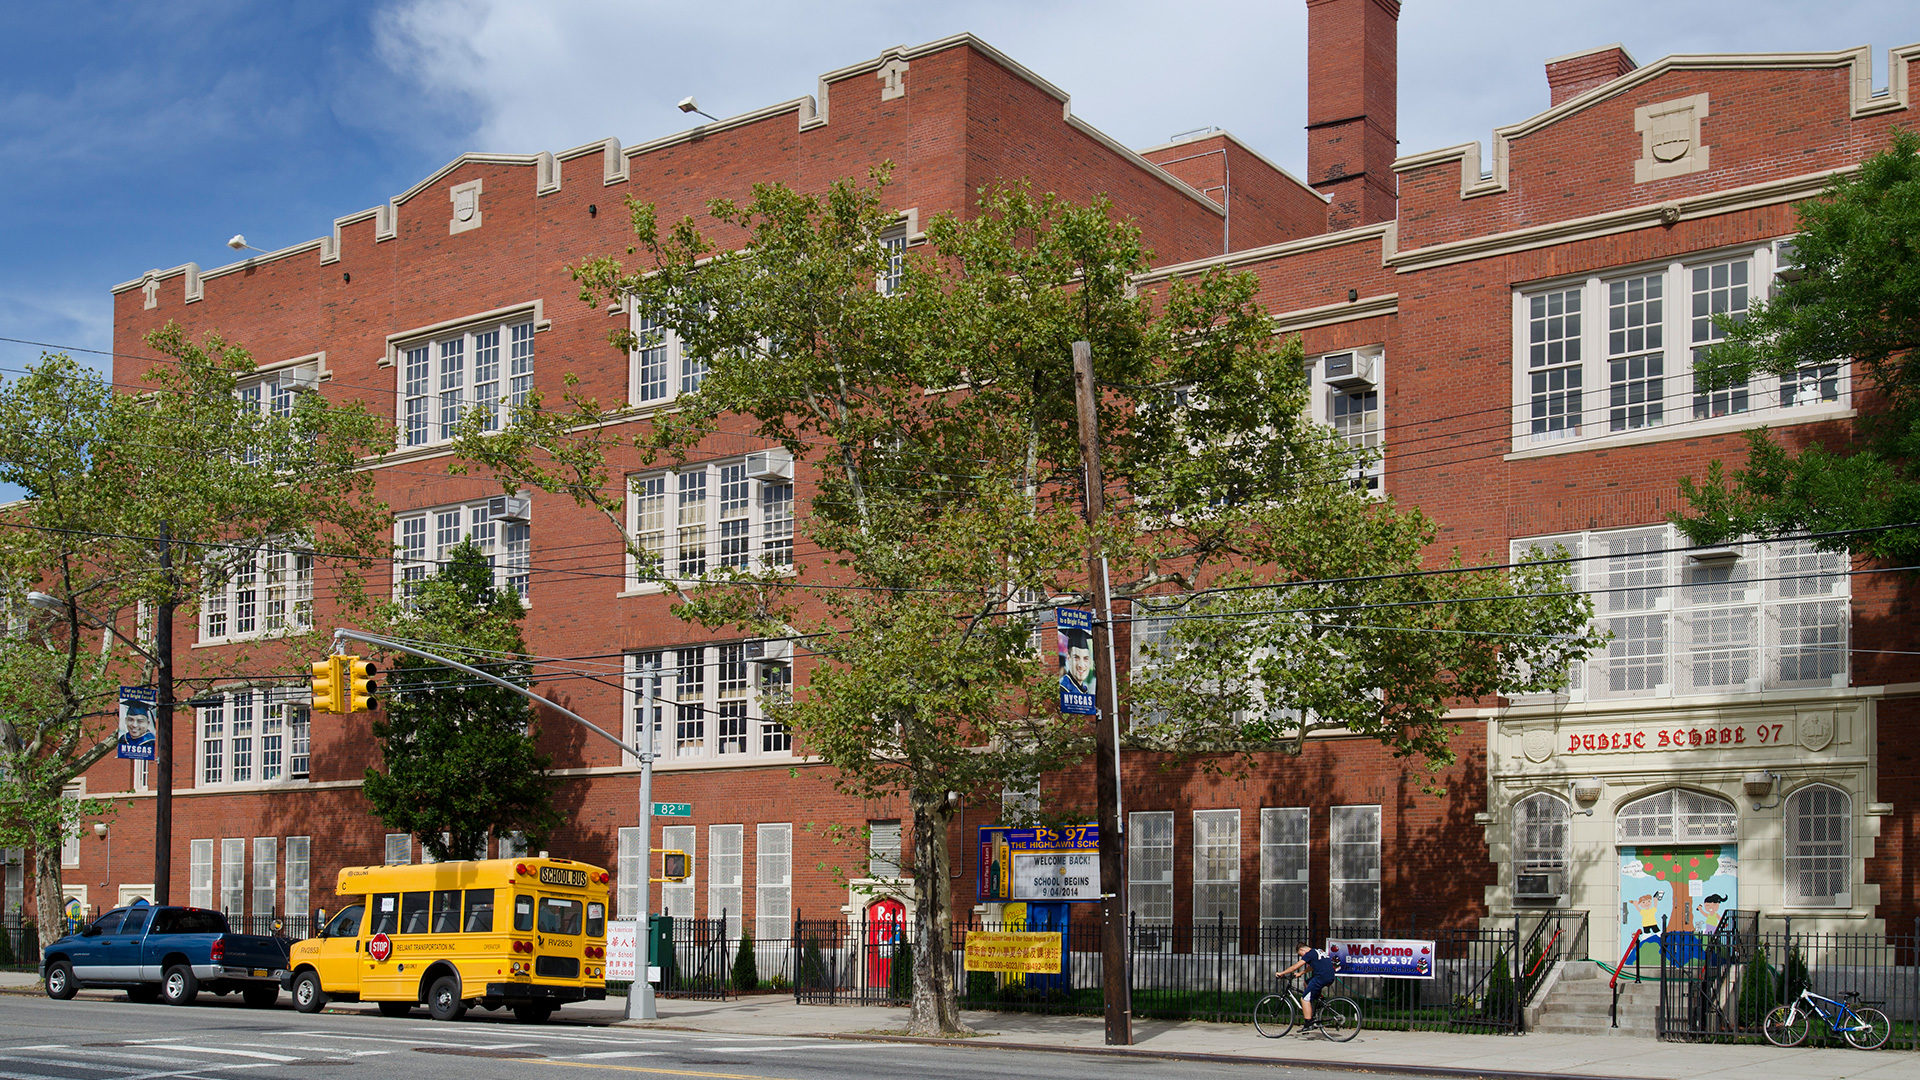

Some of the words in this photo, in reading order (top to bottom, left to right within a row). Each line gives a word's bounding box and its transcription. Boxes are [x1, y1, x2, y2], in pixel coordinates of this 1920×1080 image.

[1067, 617, 1077, 626] Bright
[1064, 694, 1093, 706] NYSCAS
[1568, 731, 1646, 753] PUBLIC
[1658, 726, 1746, 748] SCHOOL
[1757, 724, 1784, 743] 97
[121, 744, 152, 754] NYSCAS
[661, 804, 675, 814] 82
[1035, 829, 1059, 841] PS
[1065, 828, 1086, 841] 97
[1077, 840, 1099, 848] SCHO
[1034, 857, 1066, 865] WELCOME
[1069, 856, 1091, 865] BACK!
[542, 868, 570, 884] SCHOOL
[572, 871, 586, 885] BUS
[342, 882, 347, 890] C
[1034, 877, 1060, 886] SCHOOL
[1064, 877, 1089, 886] BEGINS
[1042, 888, 1078, 897] 9/04/2014
[373, 942, 388, 952] STOP
[548, 939, 573, 947] RV2853
[1347, 944, 1413, 956] Welcome
[1346, 956, 1369, 964] Back
[1370, 956, 1380, 964] to
[1381, 957, 1399, 965] P.S.
[1401, 957, 1413, 965] 97
